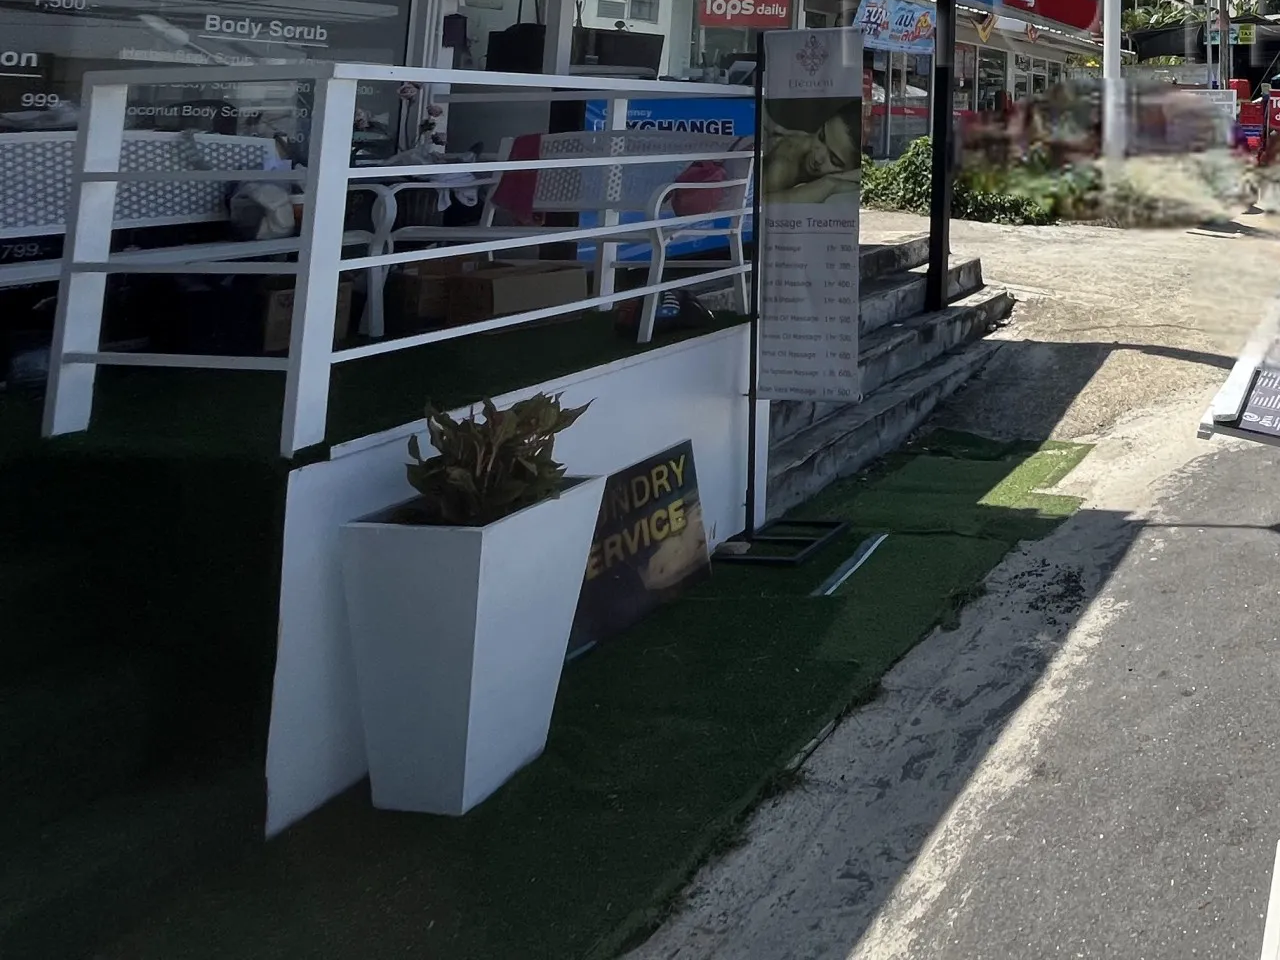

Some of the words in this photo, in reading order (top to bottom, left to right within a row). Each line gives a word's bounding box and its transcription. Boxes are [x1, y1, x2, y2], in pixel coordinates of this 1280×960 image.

[756, 3, 787, 18] daily
[205, 14, 263, 39] Body
[269, 20, 328, 41] Scrub
[127, 106, 179, 118] oconut
[182, 105, 217, 120] Body
[806, 217, 856, 228] Treatment
